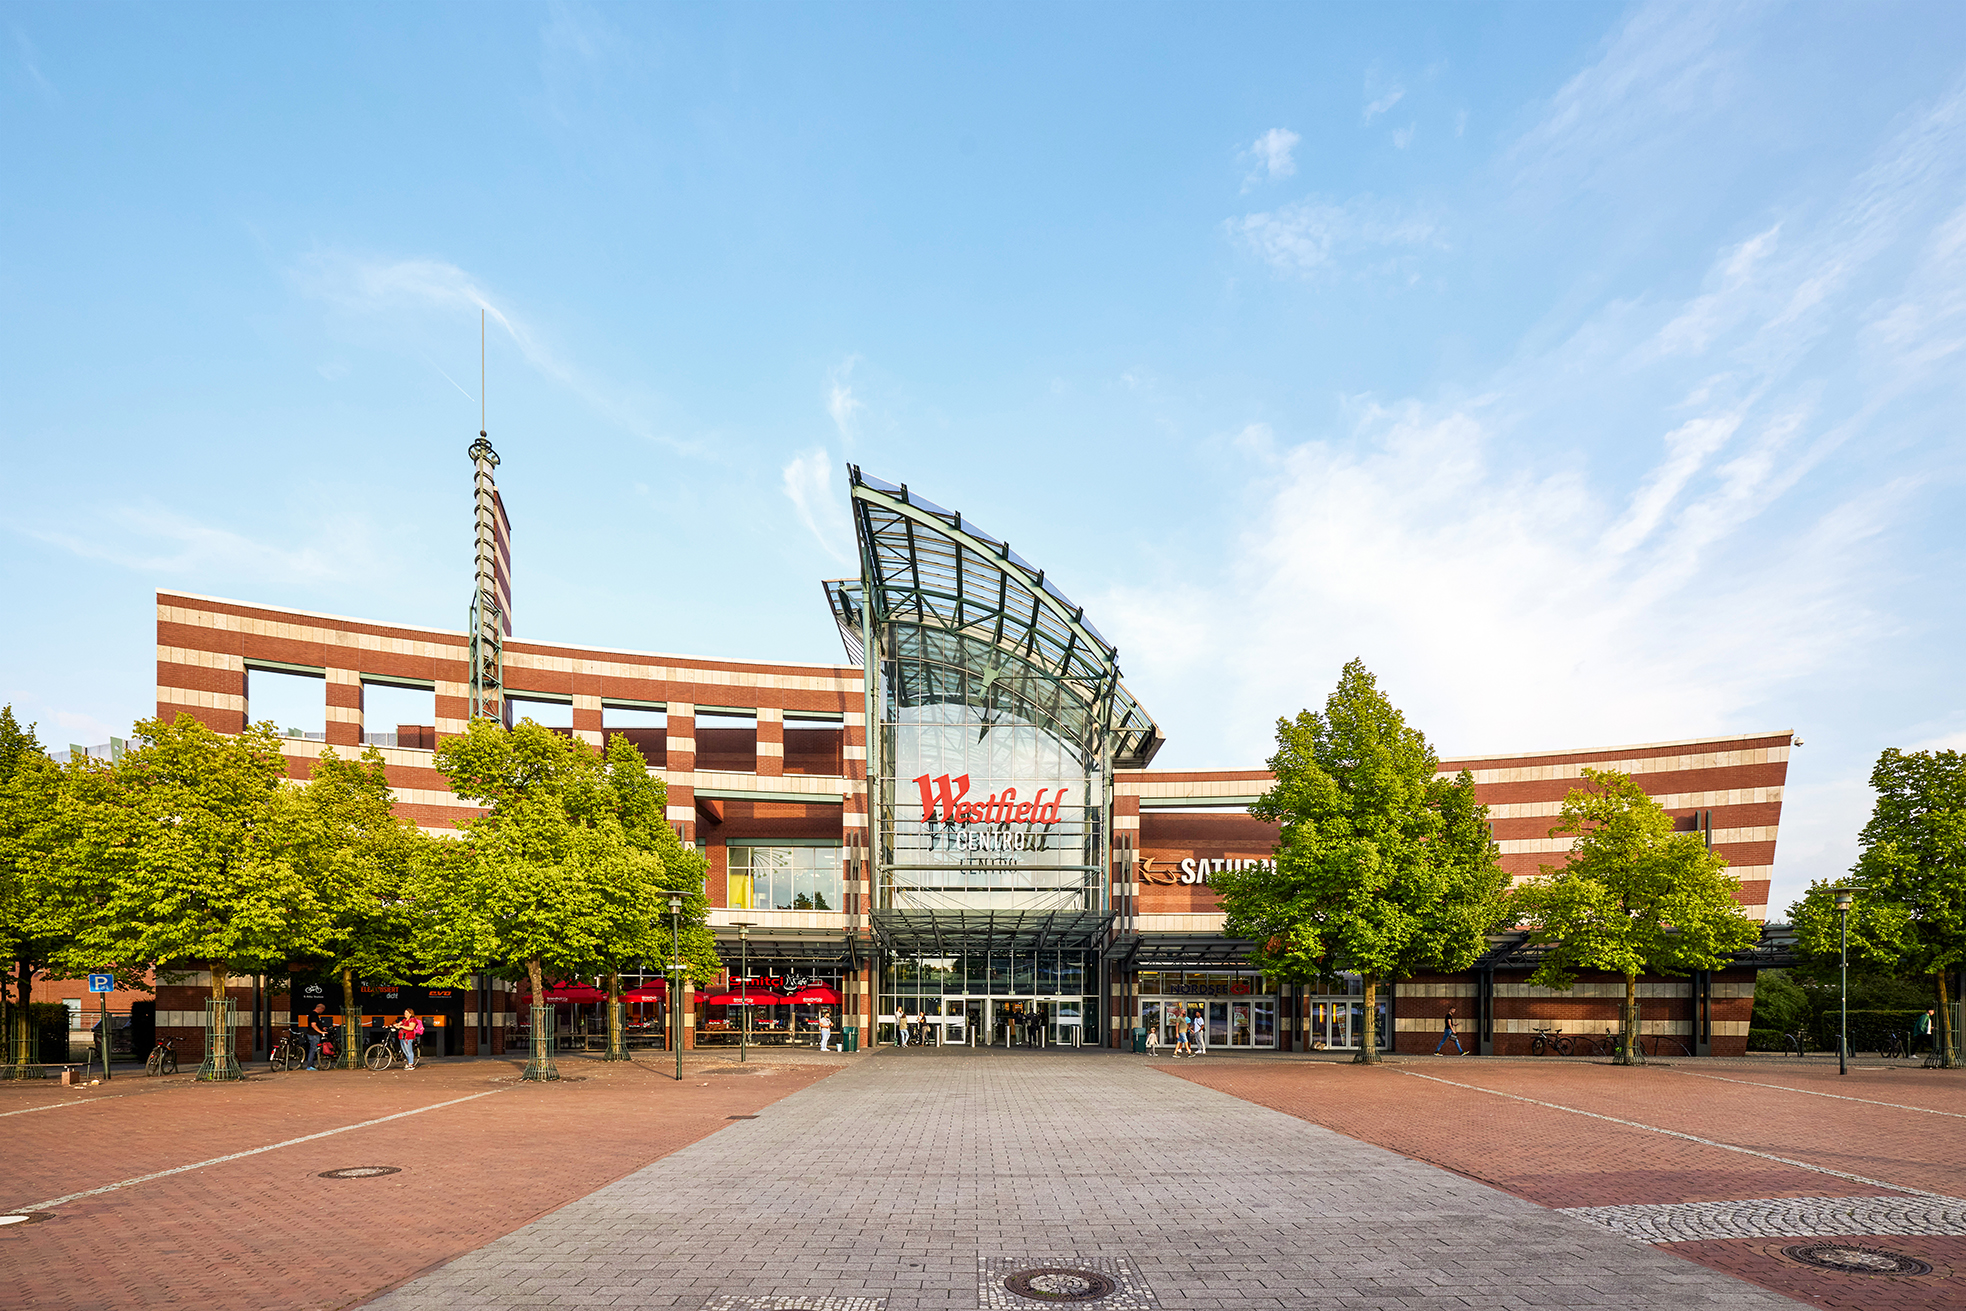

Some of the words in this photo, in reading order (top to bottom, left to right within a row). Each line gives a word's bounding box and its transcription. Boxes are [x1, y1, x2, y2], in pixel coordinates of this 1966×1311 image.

[912, 773, 1069, 825] Westfield
[956, 830, 1025, 851] CENTRO
[94, 976, 108, 990] P
[729, 975, 784, 988] Smitçi
[1170, 983, 1228, 994] NORDSEE
